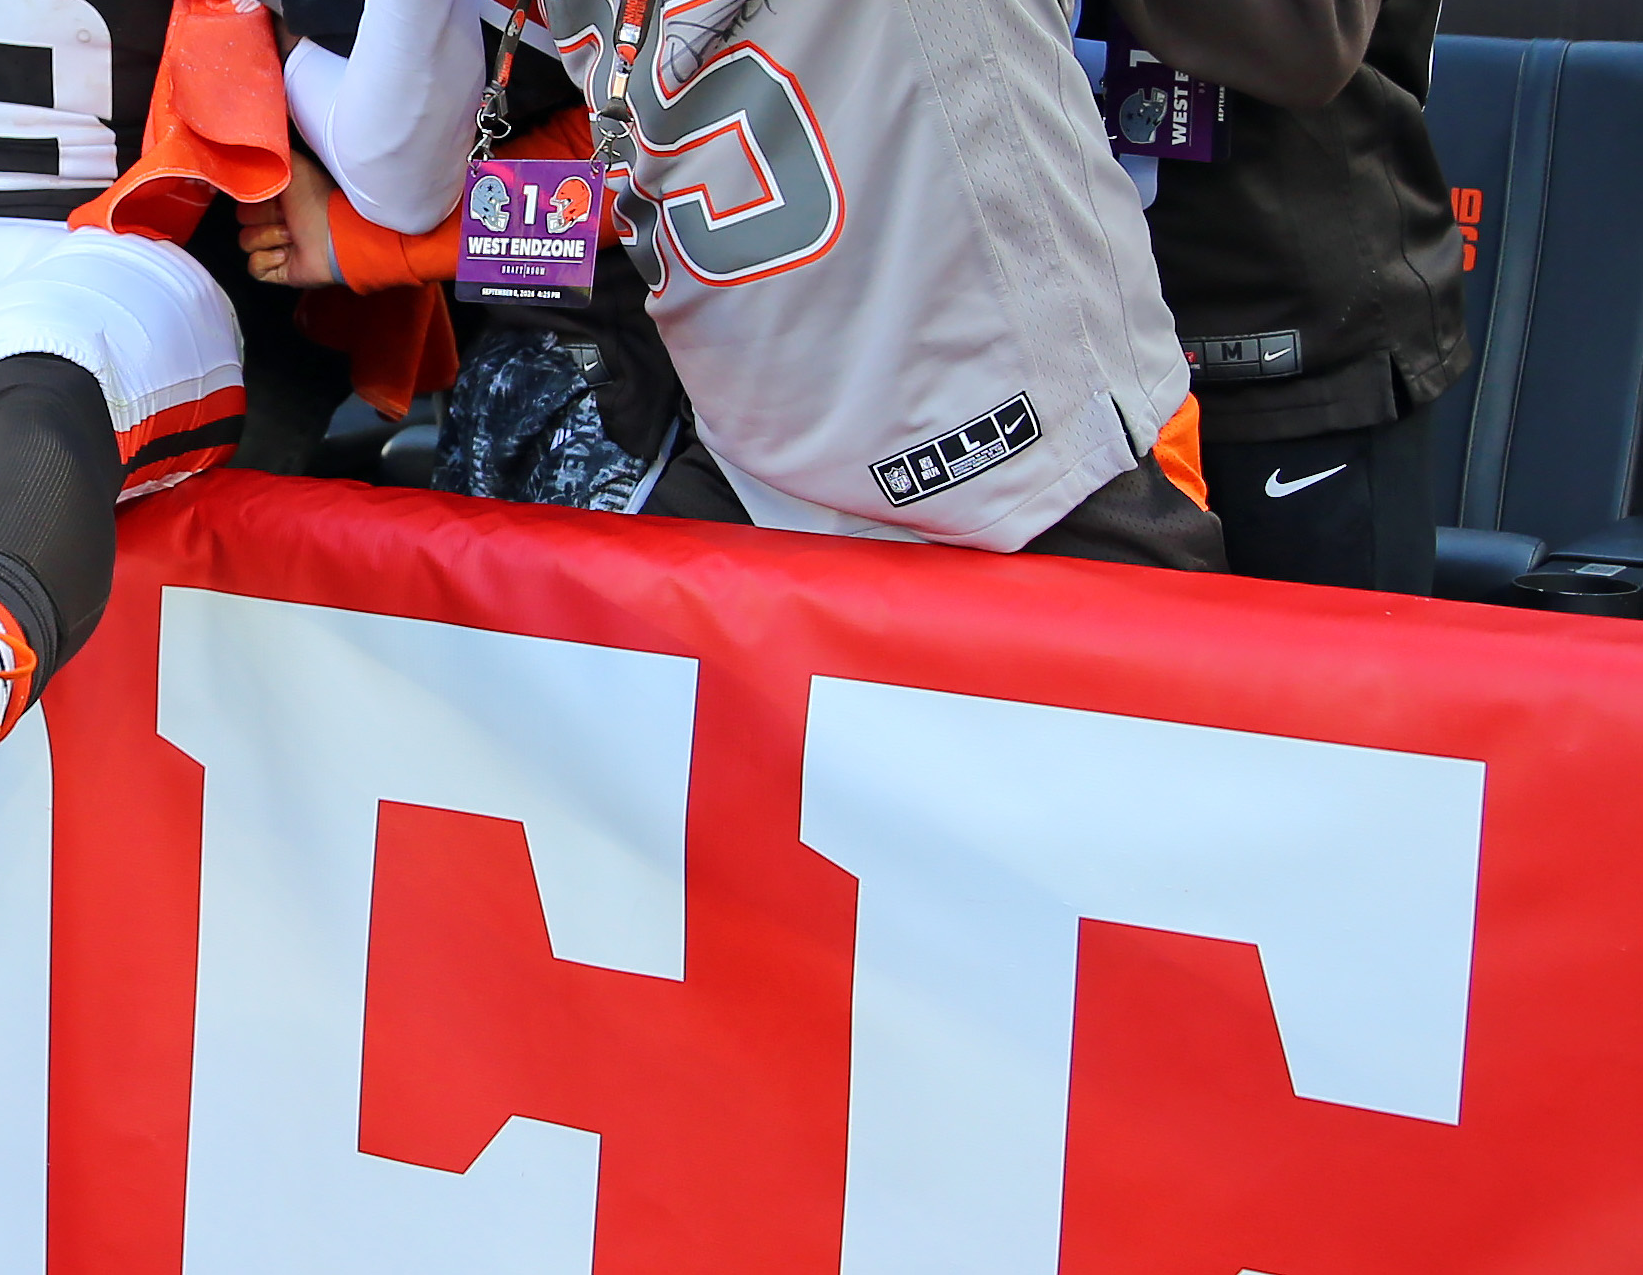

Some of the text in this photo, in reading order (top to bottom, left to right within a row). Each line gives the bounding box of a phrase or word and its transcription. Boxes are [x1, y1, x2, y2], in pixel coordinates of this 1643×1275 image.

[1171, 86, 1189, 146] WEST
[523, 185, 539, 225] 1
[468, 236, 586, 258] WEST ENDZONE
[481, 287, 512, 297] SEPTEMBER
[1221, 341, 1243, 361] M
[958, 431, 981, 453] L
